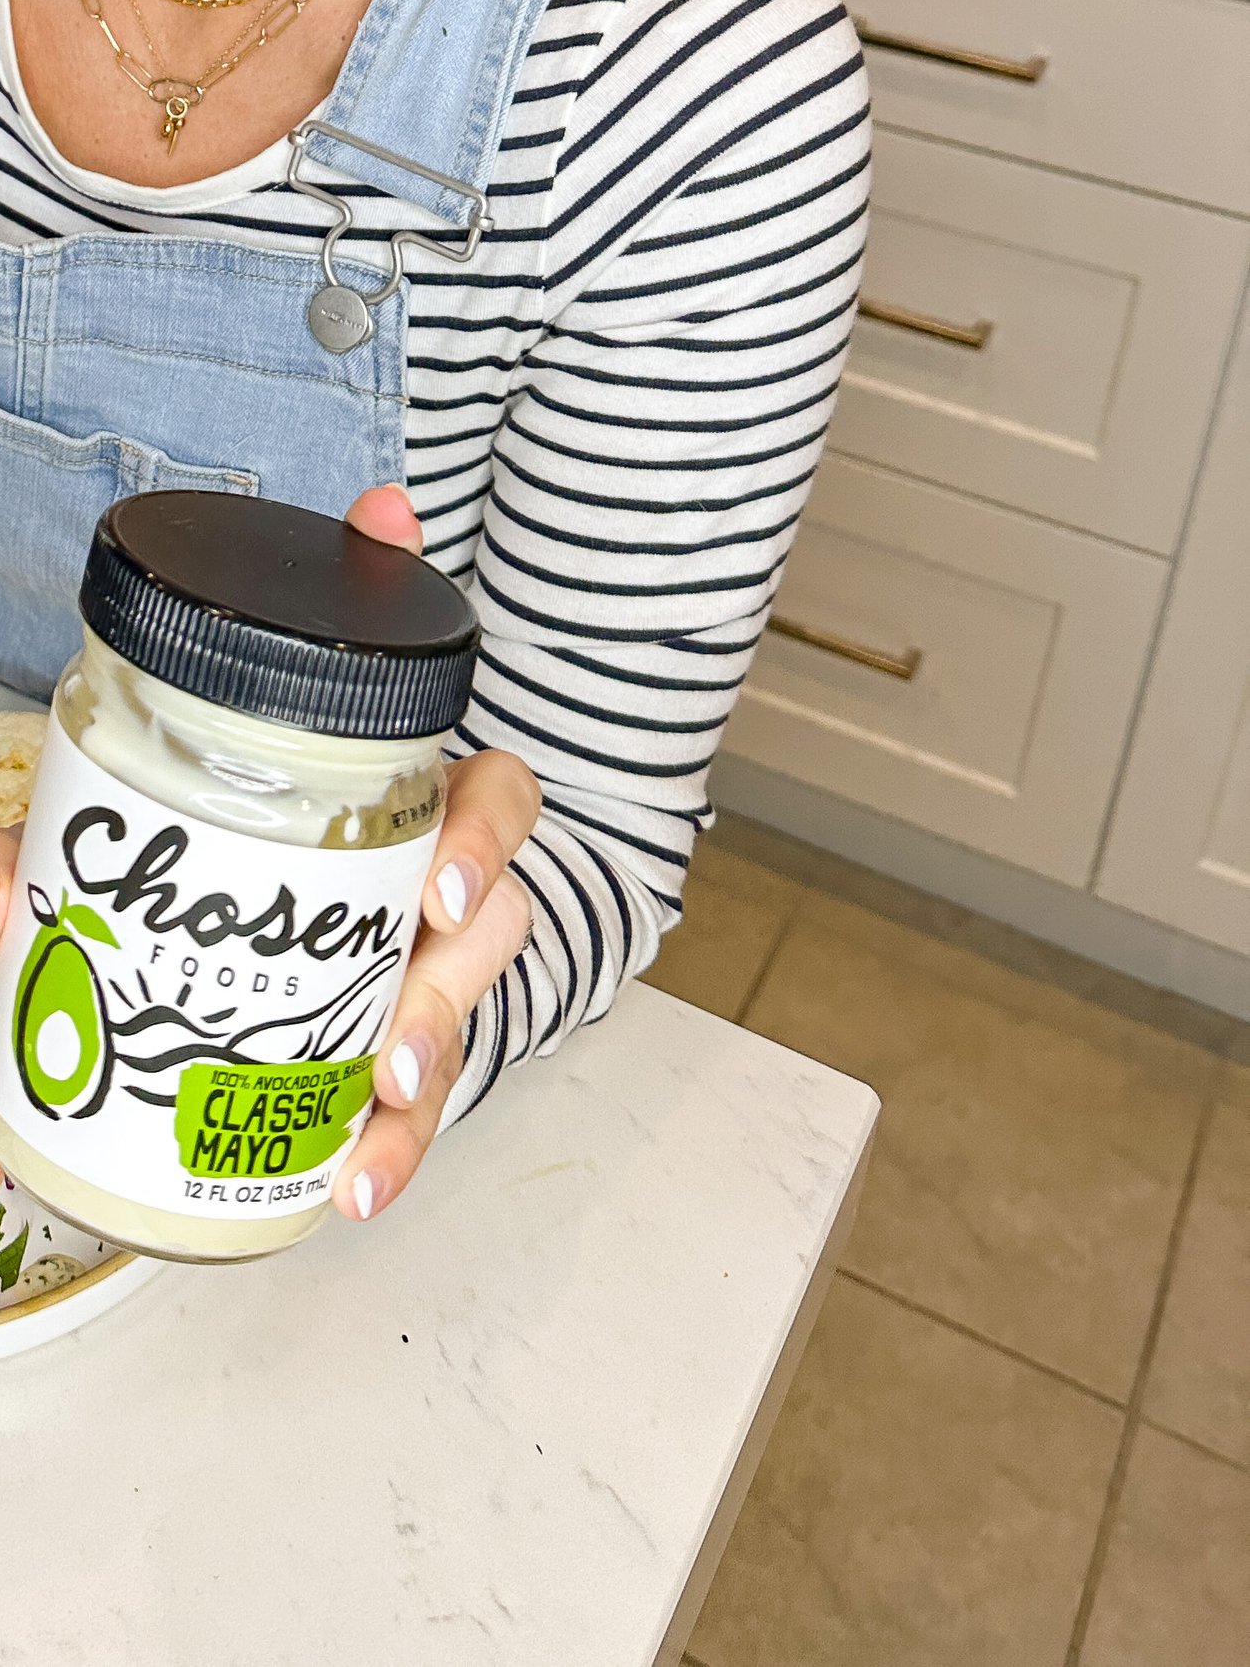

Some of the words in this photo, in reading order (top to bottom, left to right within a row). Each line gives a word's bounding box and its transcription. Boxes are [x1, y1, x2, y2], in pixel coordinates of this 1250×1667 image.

[61, 806, 405, 960] Chosen
[150, 944, 299, 997] FOODS
[211, 1070, 251, 1089] 100%
[253, 1074, 320, 1091] AVOCADO
[322, 1070, 342, 1086] OIL
[203, 1085, 339, 1133] CLASSIC
[190, 1129, 293, 1174] MAYO
[184, 1181, 203, 1199] 12
[208, 1185, 228, 1202] FL
[236, 1186, 263, 1203] OZ
[268, 1181, 302, 1205] (355
